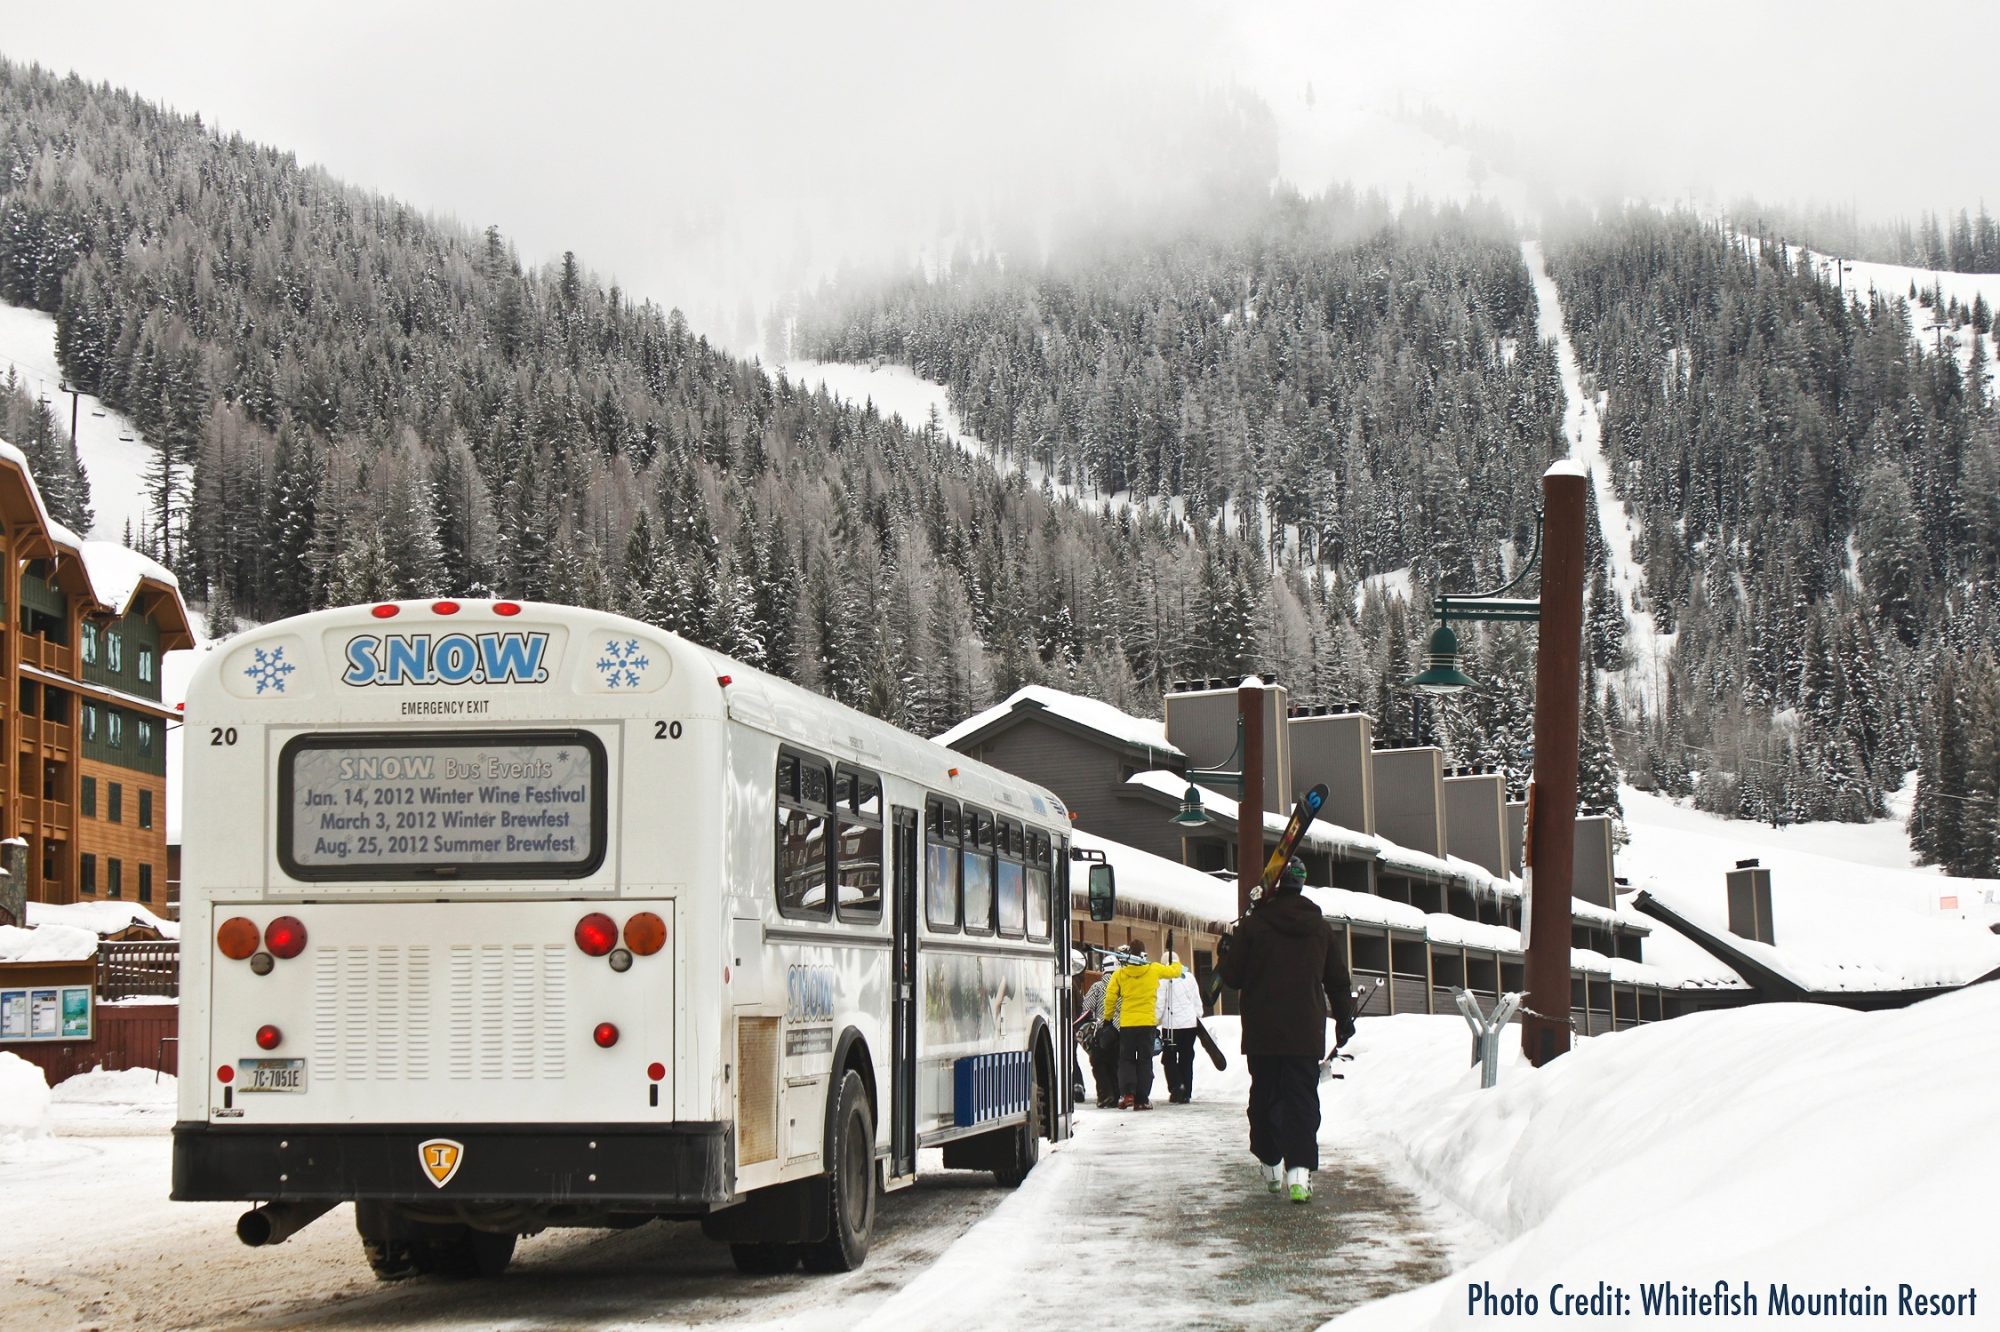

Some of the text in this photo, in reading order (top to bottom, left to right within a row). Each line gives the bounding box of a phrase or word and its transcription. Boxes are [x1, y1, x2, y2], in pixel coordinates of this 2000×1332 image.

[341, 630, 550, 687] S.N.O.W.
[401, 700, 490, 715] EMERGENCY EXIT
[210, 727, 238, 747] 20
[654, 721, 683, 740] 20
[339, 756, 552, 781] S.N.O.W. Bus Events
[304, 785, 586, 808] Jan. 14, 2012 Winter Wine Festival
[320, 808, 570, 832] March 3, 2012 Winter Brewfest
[314, 832, 575, 858] Aug. 25, 2012 Summer Brewfest
[253, 1070, 300, 1087] 7C-7051E
